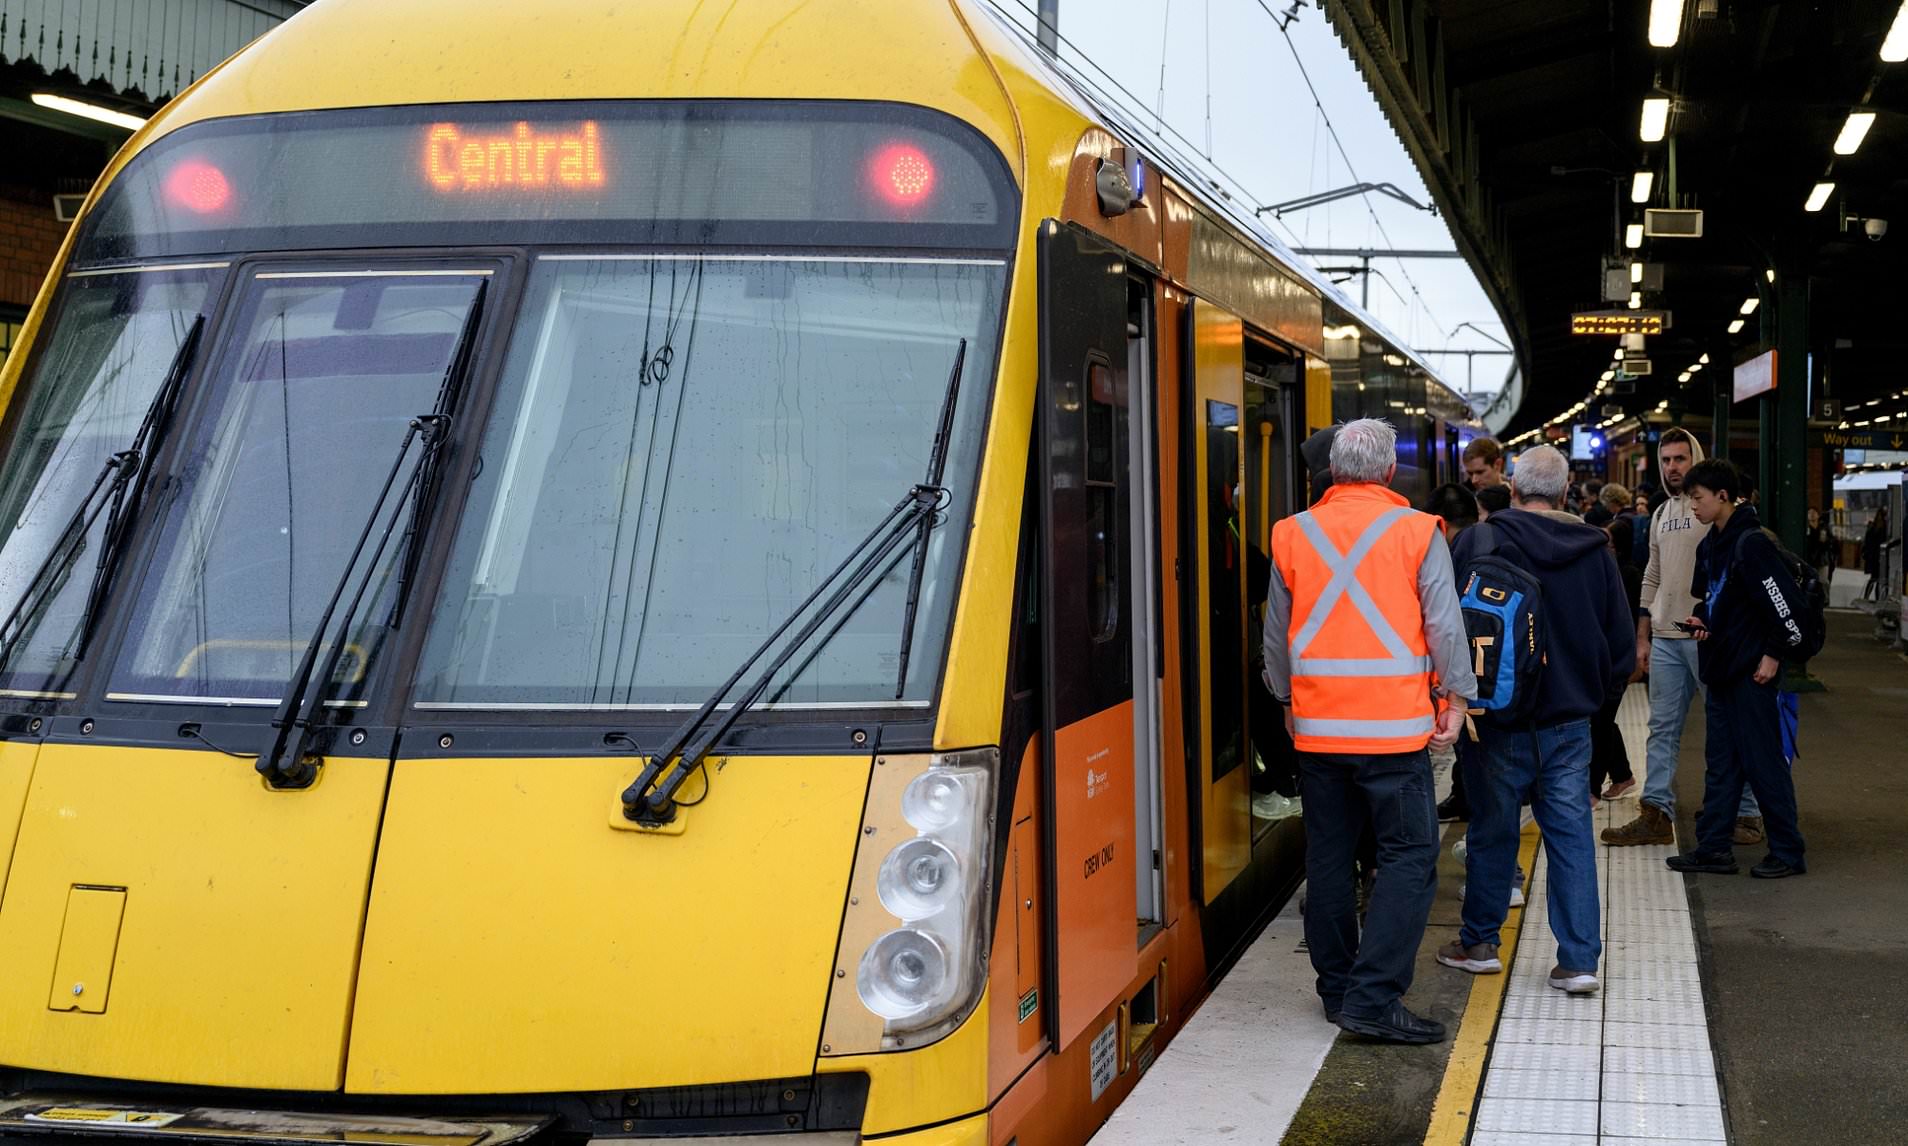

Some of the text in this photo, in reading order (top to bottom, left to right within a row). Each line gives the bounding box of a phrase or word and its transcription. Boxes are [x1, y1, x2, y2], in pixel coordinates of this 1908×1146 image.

[429, 121, 604, 184] Central
[1823, 403, 1833, 417] 5
[1823, 431, 1873, 447] Way out
[1661, 517, 1691, 533] FILA
[1762, 576, 1791, 618] NSBHS
[1084, 841, 1114, 879] CREW ONLY
